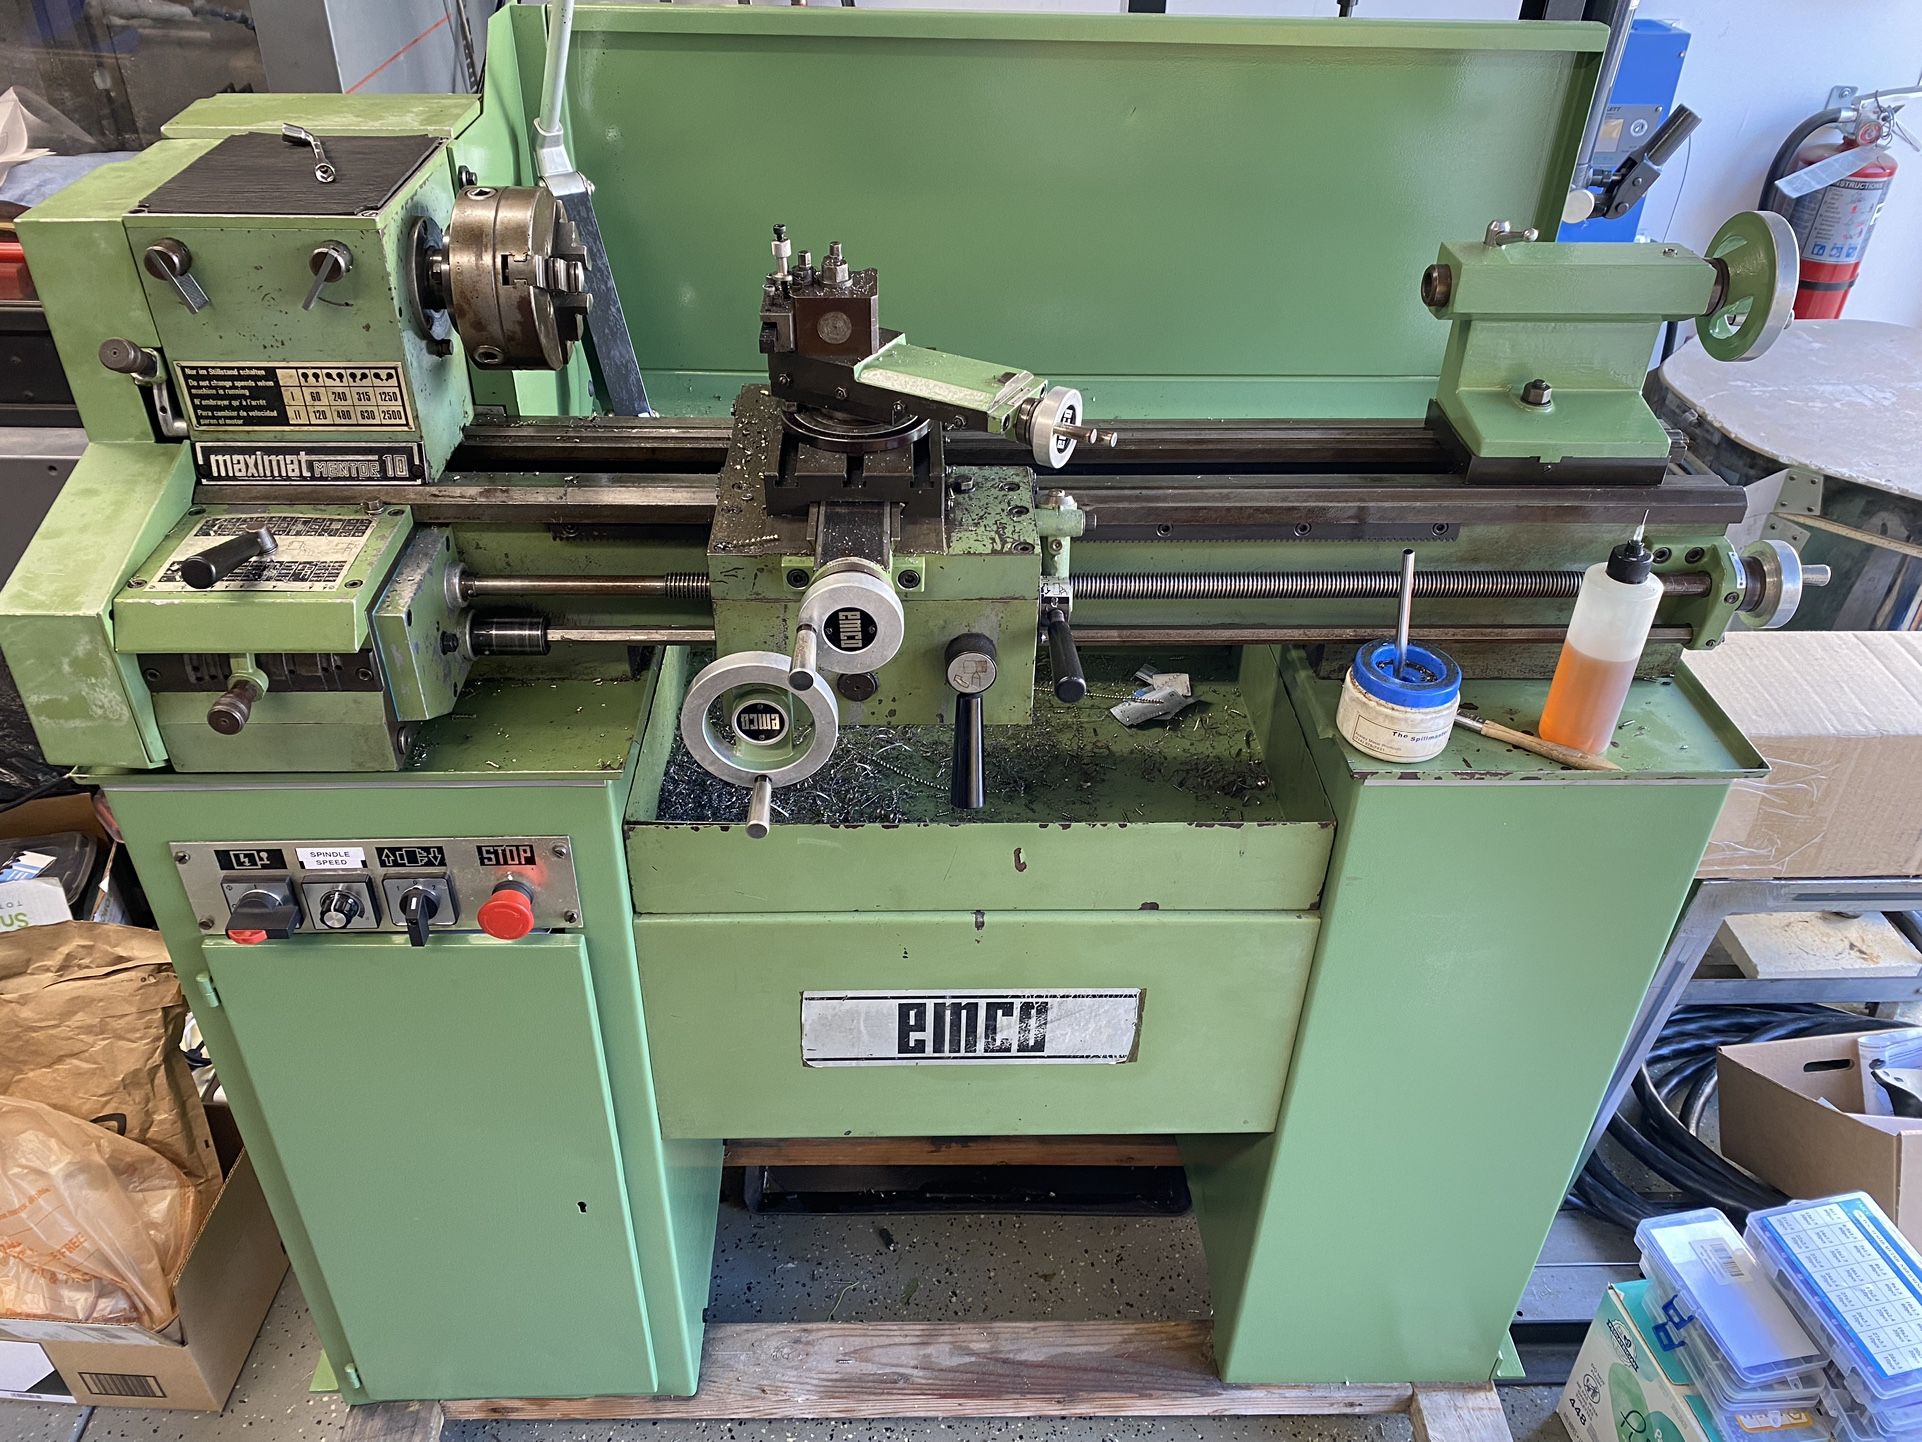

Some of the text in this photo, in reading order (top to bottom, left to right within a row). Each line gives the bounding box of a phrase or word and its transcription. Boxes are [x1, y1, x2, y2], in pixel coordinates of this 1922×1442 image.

[1836, 181, 1883, 189] STRUCTIONS
[310, 391, 321, 401] 60
[332, 391, 347, 401] 240
[356, 391, 371, 401] 315
[379, 391, 398, 401] 1250
[313, 410, 327, 420] 120
[336, 410, 352, 420] 480
[360, 410, 376, 420] 630
[381, 410, 402, 420] 2500
[209, 451, 409, 478] maximat MENTOR 10
[838, 611, 863, 648] emco
[741, 713, 780, 730] emco
[1392, 731, 1408, 739] The
[481, 846, 531, 864] STOP
[898, 1001, 1049, 1054] emco
[1569, 1398, 1586, 1426] 448
